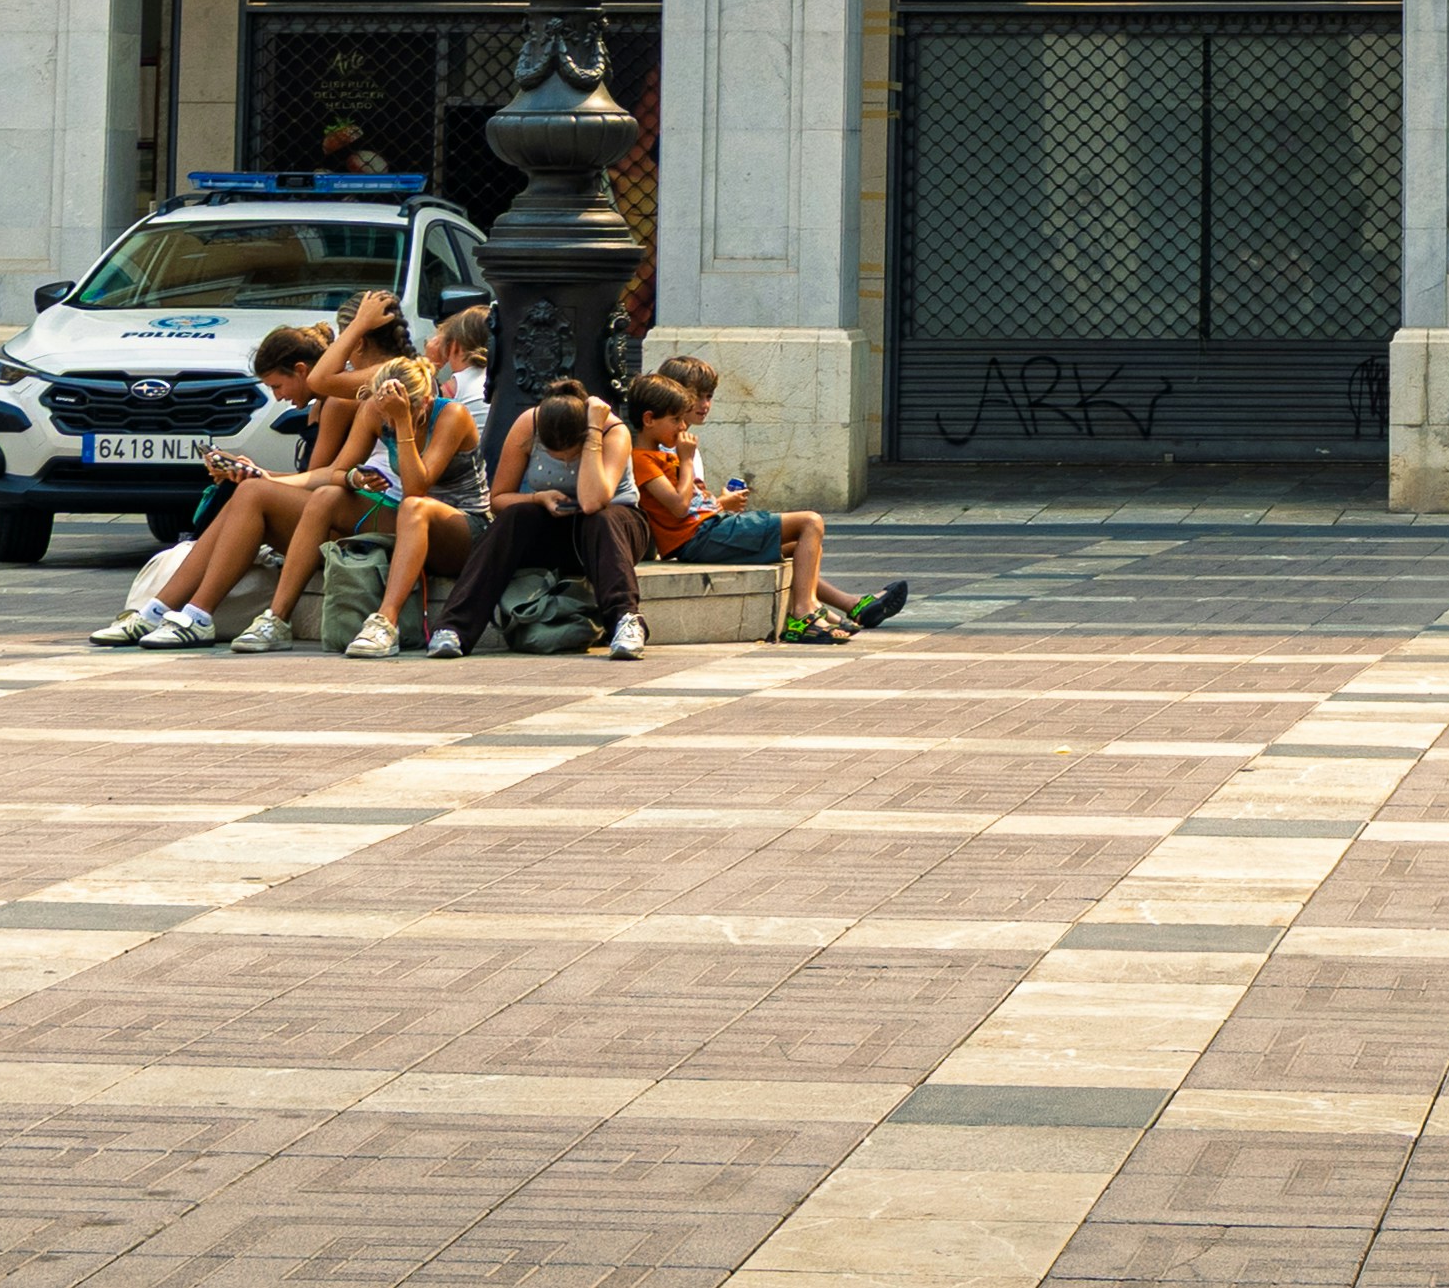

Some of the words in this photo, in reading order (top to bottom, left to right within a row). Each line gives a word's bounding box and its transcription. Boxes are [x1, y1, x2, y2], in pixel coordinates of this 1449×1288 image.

[331, 50, 364, 77] Arte
[321, 80, 378, 89] DISFRUTA
[314, 91, 336, 99] DEL
[341, 91, 384, 99] PLACER
[326, 102, 373, 110] HELADO
[120, 331, 217, 340] POLICIA
[99, 438, 155, 460] 6418
